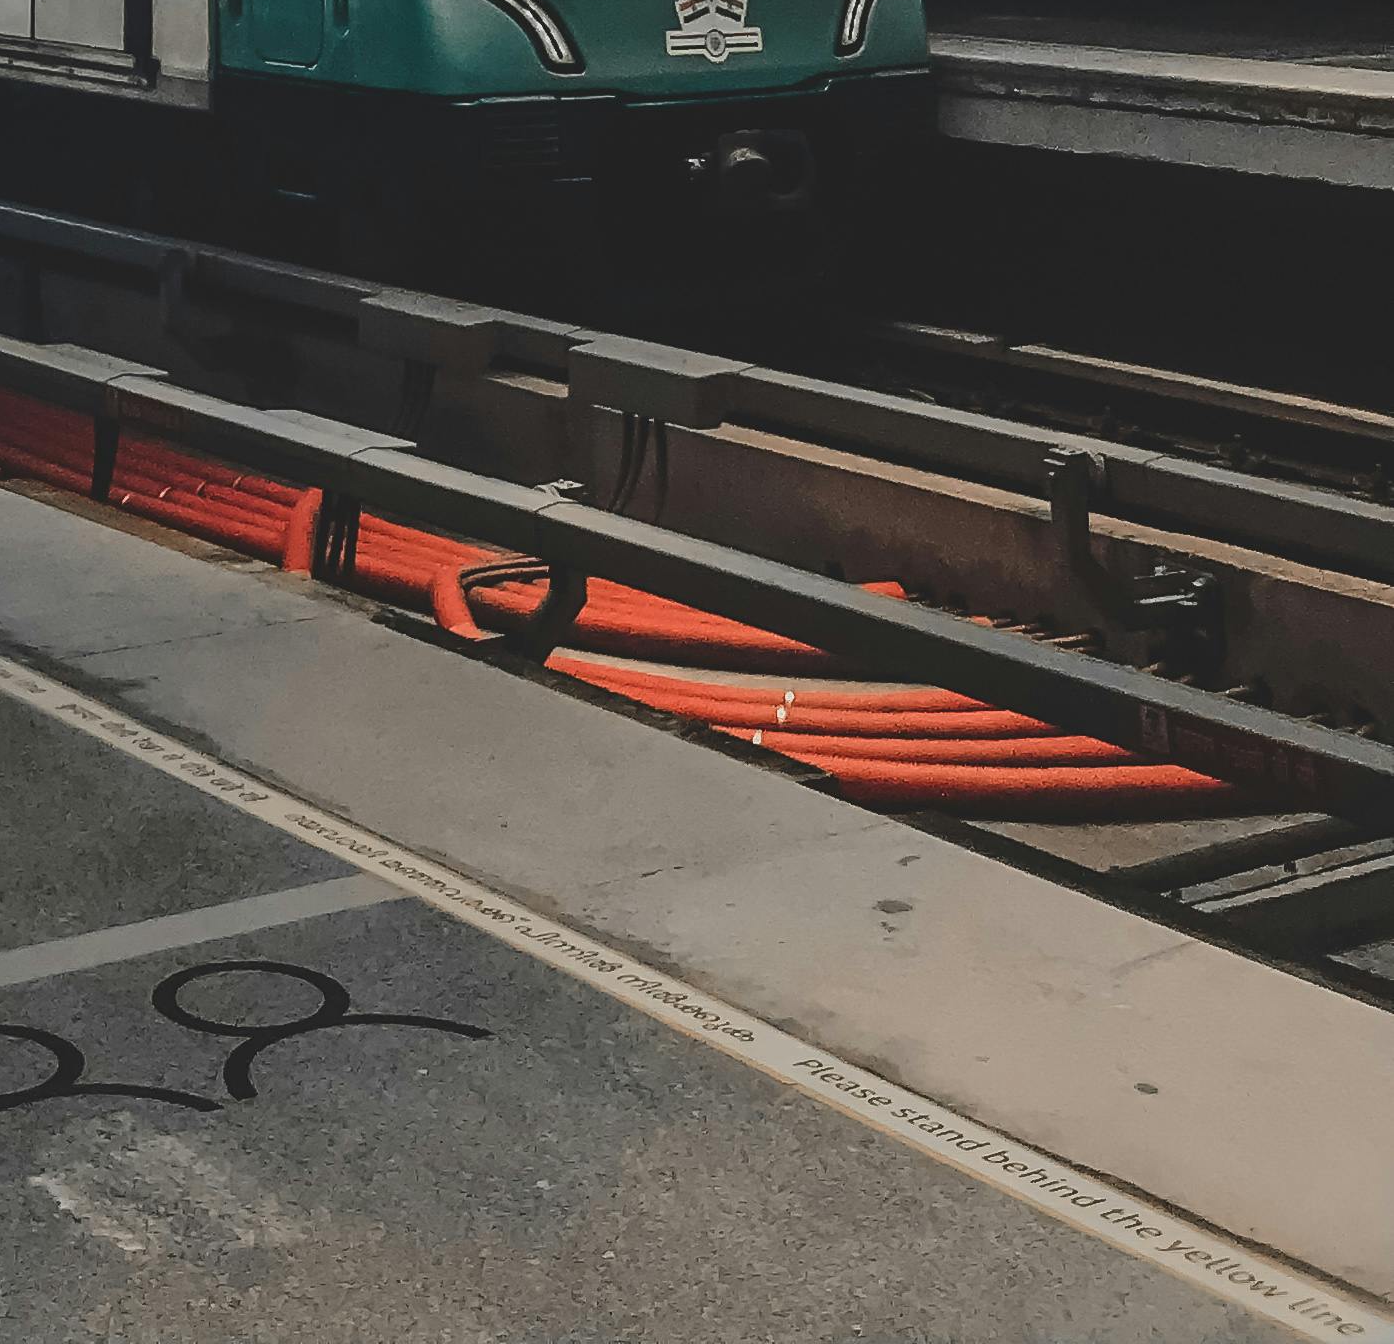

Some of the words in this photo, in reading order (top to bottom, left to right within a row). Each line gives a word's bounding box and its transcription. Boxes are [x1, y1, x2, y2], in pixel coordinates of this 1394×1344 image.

[792, 1059, 893, 1107] Please
[890, 1107, 991, 1151] stand
[982, 1150, 1106, 1208] behind
[1100, 1208, 1162, 1238] the
[1155, 1239, 1288, 1297] yellow
[1288, 1297, 1366, 1336] line
